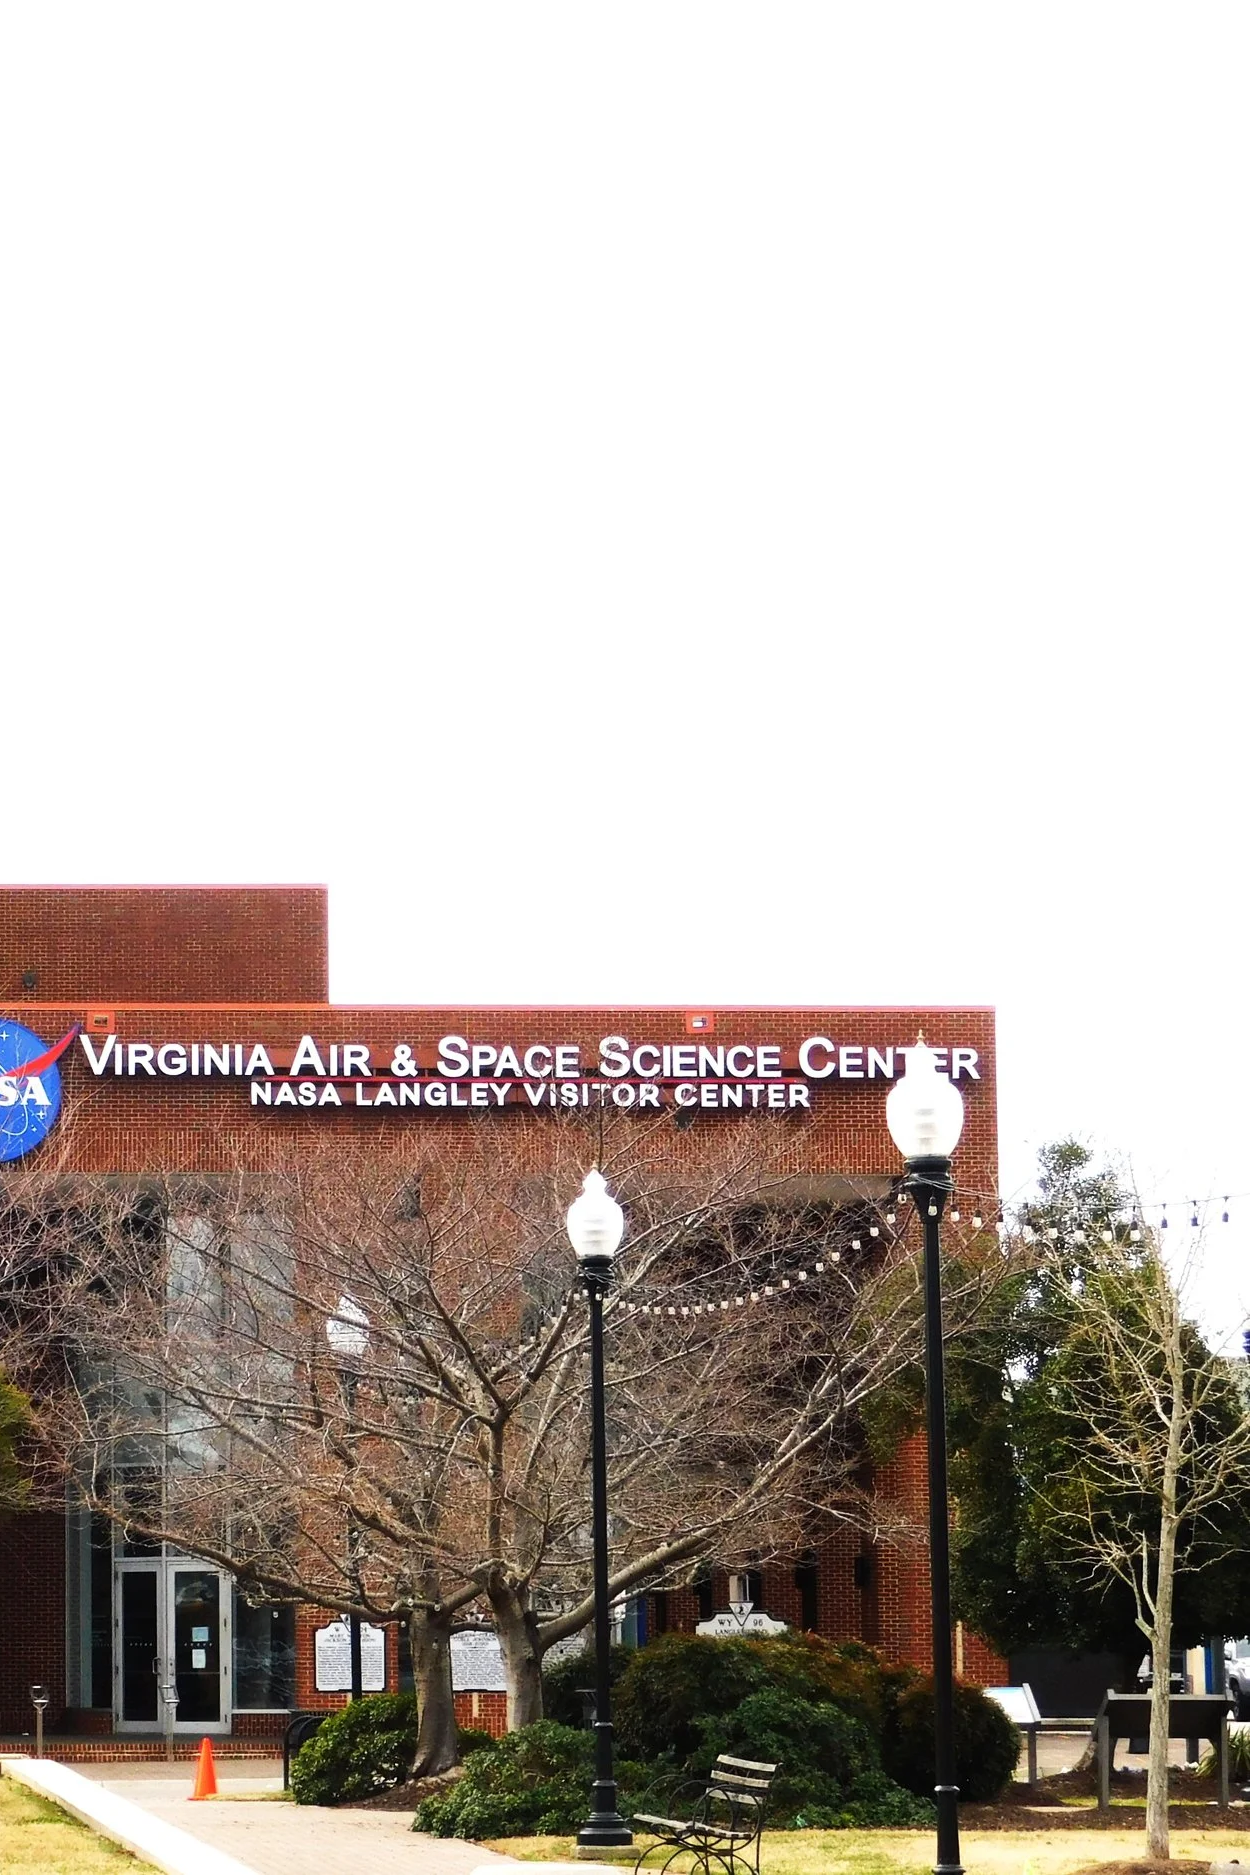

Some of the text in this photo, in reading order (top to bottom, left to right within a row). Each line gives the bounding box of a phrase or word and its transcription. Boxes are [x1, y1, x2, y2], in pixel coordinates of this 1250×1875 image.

[79, 1034, 273, 1076] VIRGINIA
[290, 1035, 371, 1077] AIR
[390, 1044, 418, 1077] &
[436, 1035, 580, 1078] SPACE
[599, 1036, 782, 1078] SCIENCE
[250, 1082, 810, 1108] NASA LANGLEY VISITOR CENTER
[717, 1618, 764, 1627] WY 96
